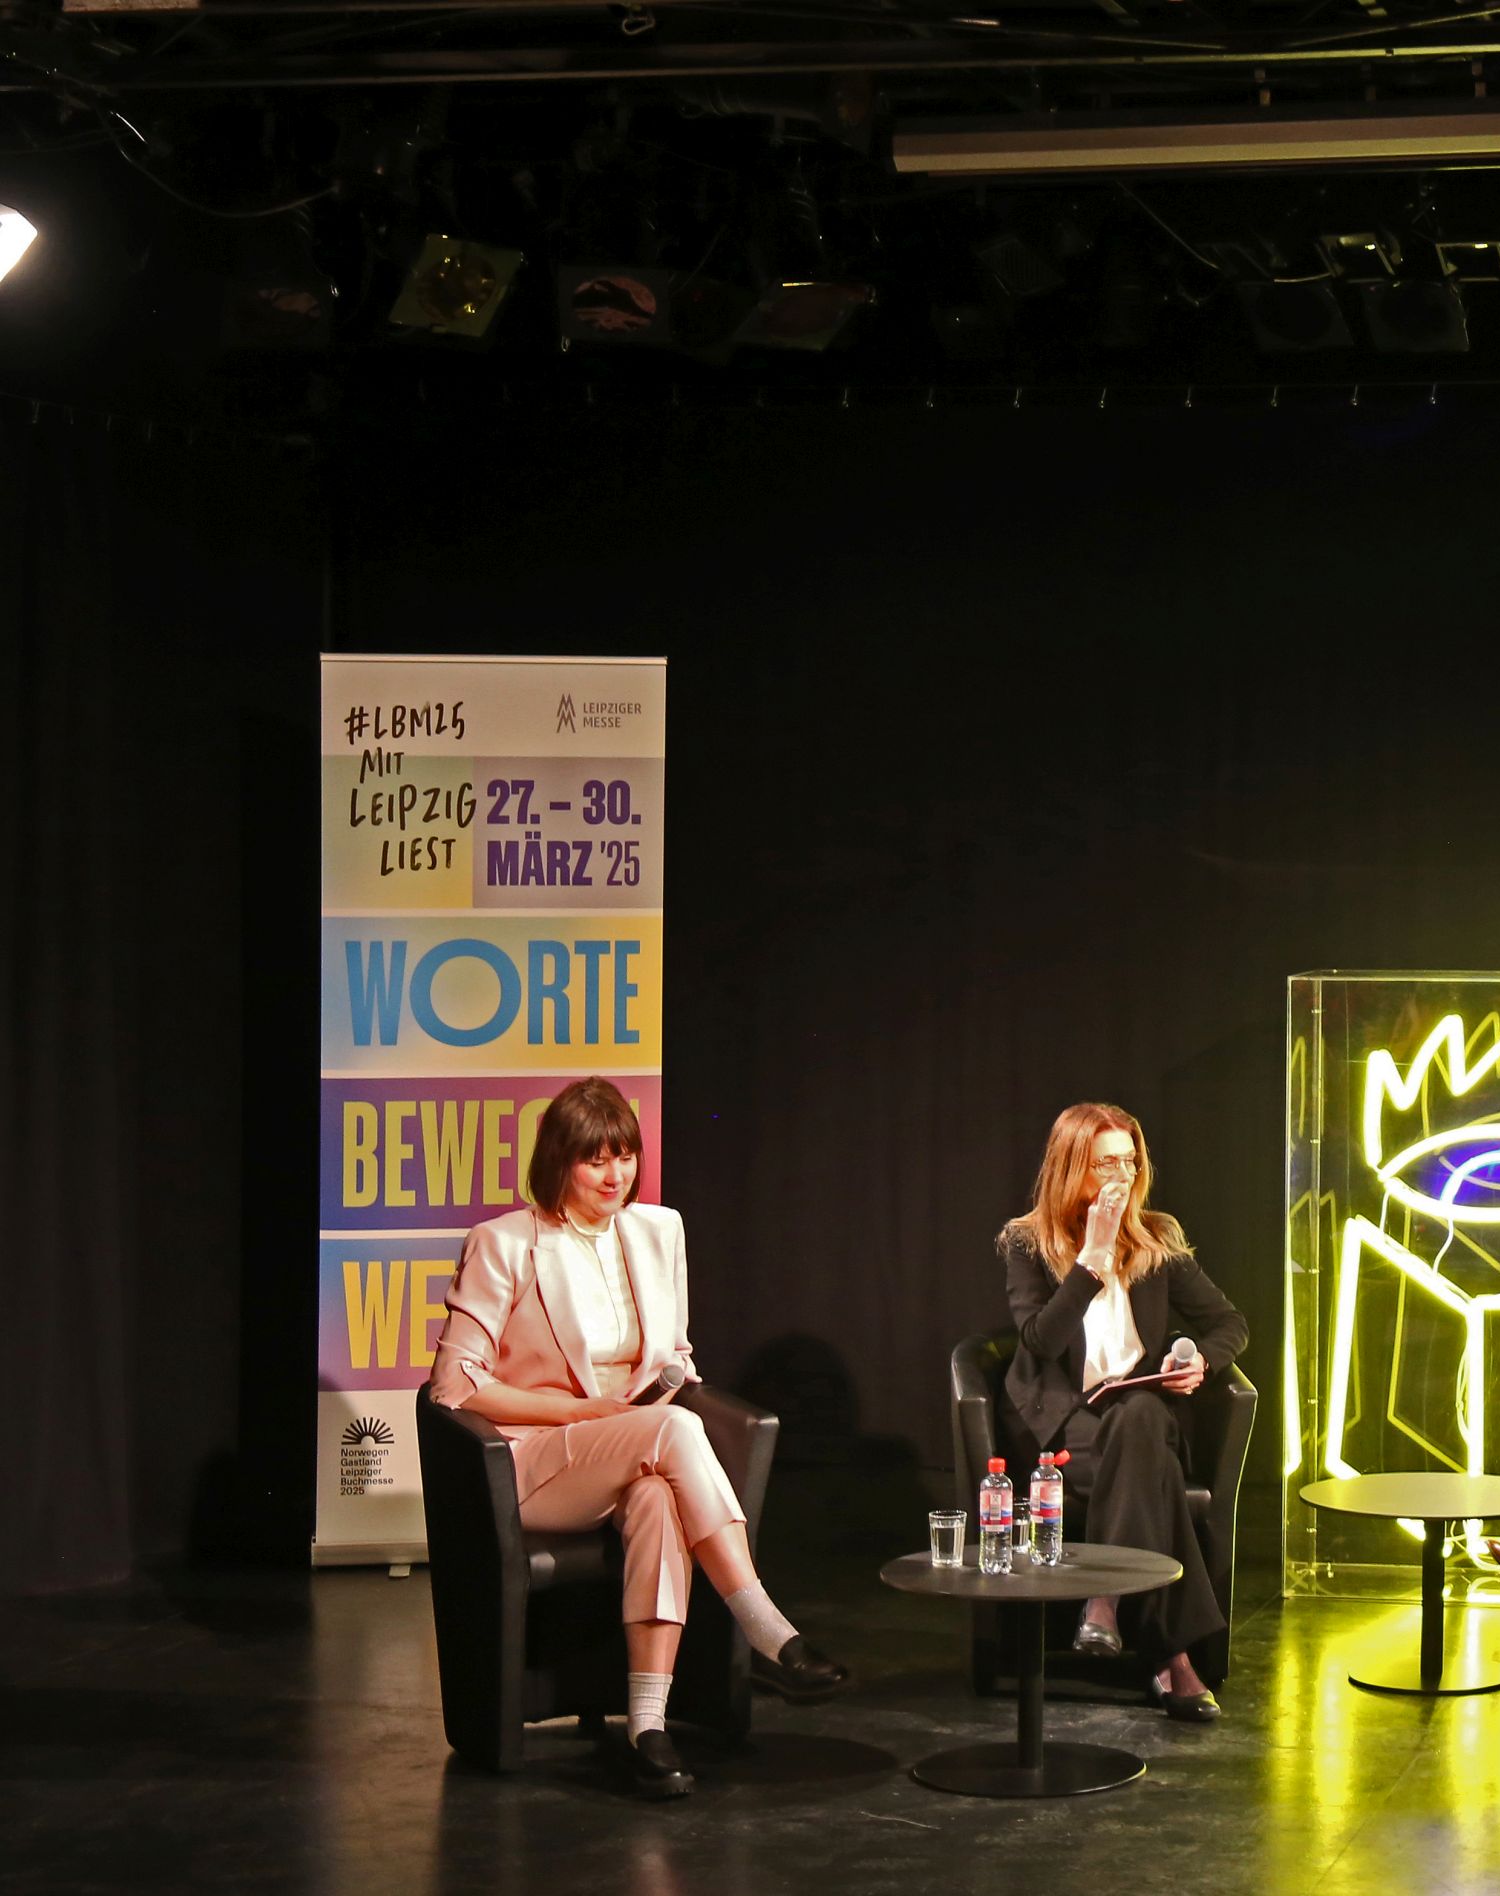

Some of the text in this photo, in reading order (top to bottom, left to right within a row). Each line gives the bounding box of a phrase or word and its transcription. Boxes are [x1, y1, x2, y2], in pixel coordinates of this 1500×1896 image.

[344, 701, 465, 745] #LBM25
[583, 702, 642, 715] LEIPZIGER
[583, 717, 621, 728] MESSE
[360, 747, 405, 784] MIT
[350, 783, 477, 831] LEIPZIG
[486, 780, 540, 825] 27.
[583, 781, 641, 825] 30.
[380, 836, 456, 877] LIEST
[487, 831, 640, 887] MÄRZ '25
[345, 938, 641, 1047] WORTE
[342, 1098, 640, 1208] BEWE
[342, 1260, 456, 1369] WE
[340, 1448, 389, 1458] Norwegen
[340, 1457, 382, 1467] Gastland
[340, 1467, 382, 1477] Leipziger
[340, 1477, 394, 1486] Buchmesse
[340, 1486, 365, 1496] 2025
